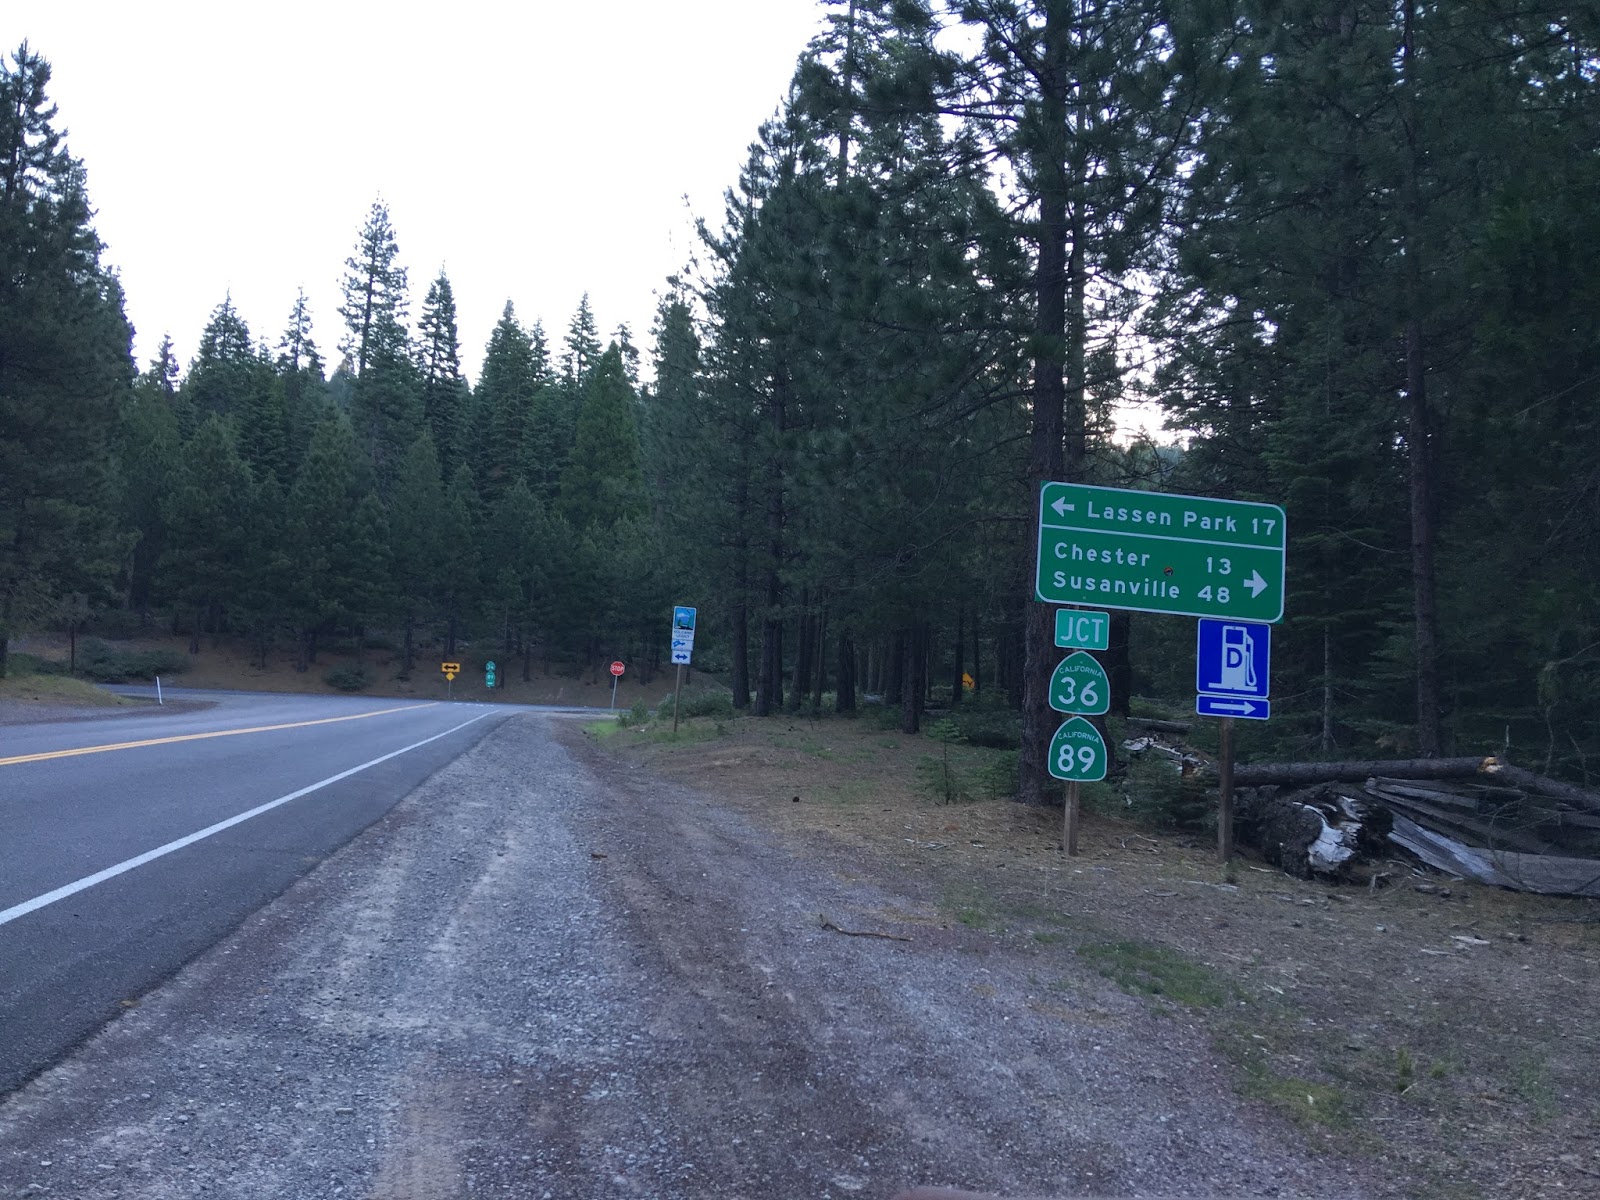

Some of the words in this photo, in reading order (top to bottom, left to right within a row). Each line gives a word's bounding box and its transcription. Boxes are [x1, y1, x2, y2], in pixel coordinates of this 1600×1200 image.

[1087, 501, 1171, 525] Lassen
[1184, 511, 1236, 532] Park
[1252, 518, 1276, 536] 17
[1054, 542, 1150, 567] Chester
[1207, 556, 1231, 574] 13
[1053, 571, 1179, 598] Susanville
[1197, 585, 1230, 603] 48
[1060, 617, 1103, 642] JCT
[1059, 665, 1102, 678] CALIFORNIA
[1227, 647, 1243, 668] D
[1058, 677, 1098, 706] 36
[1058, 731, 1099, 744] CALIFORNIA
[1057, 744, 1095, 773] 89
